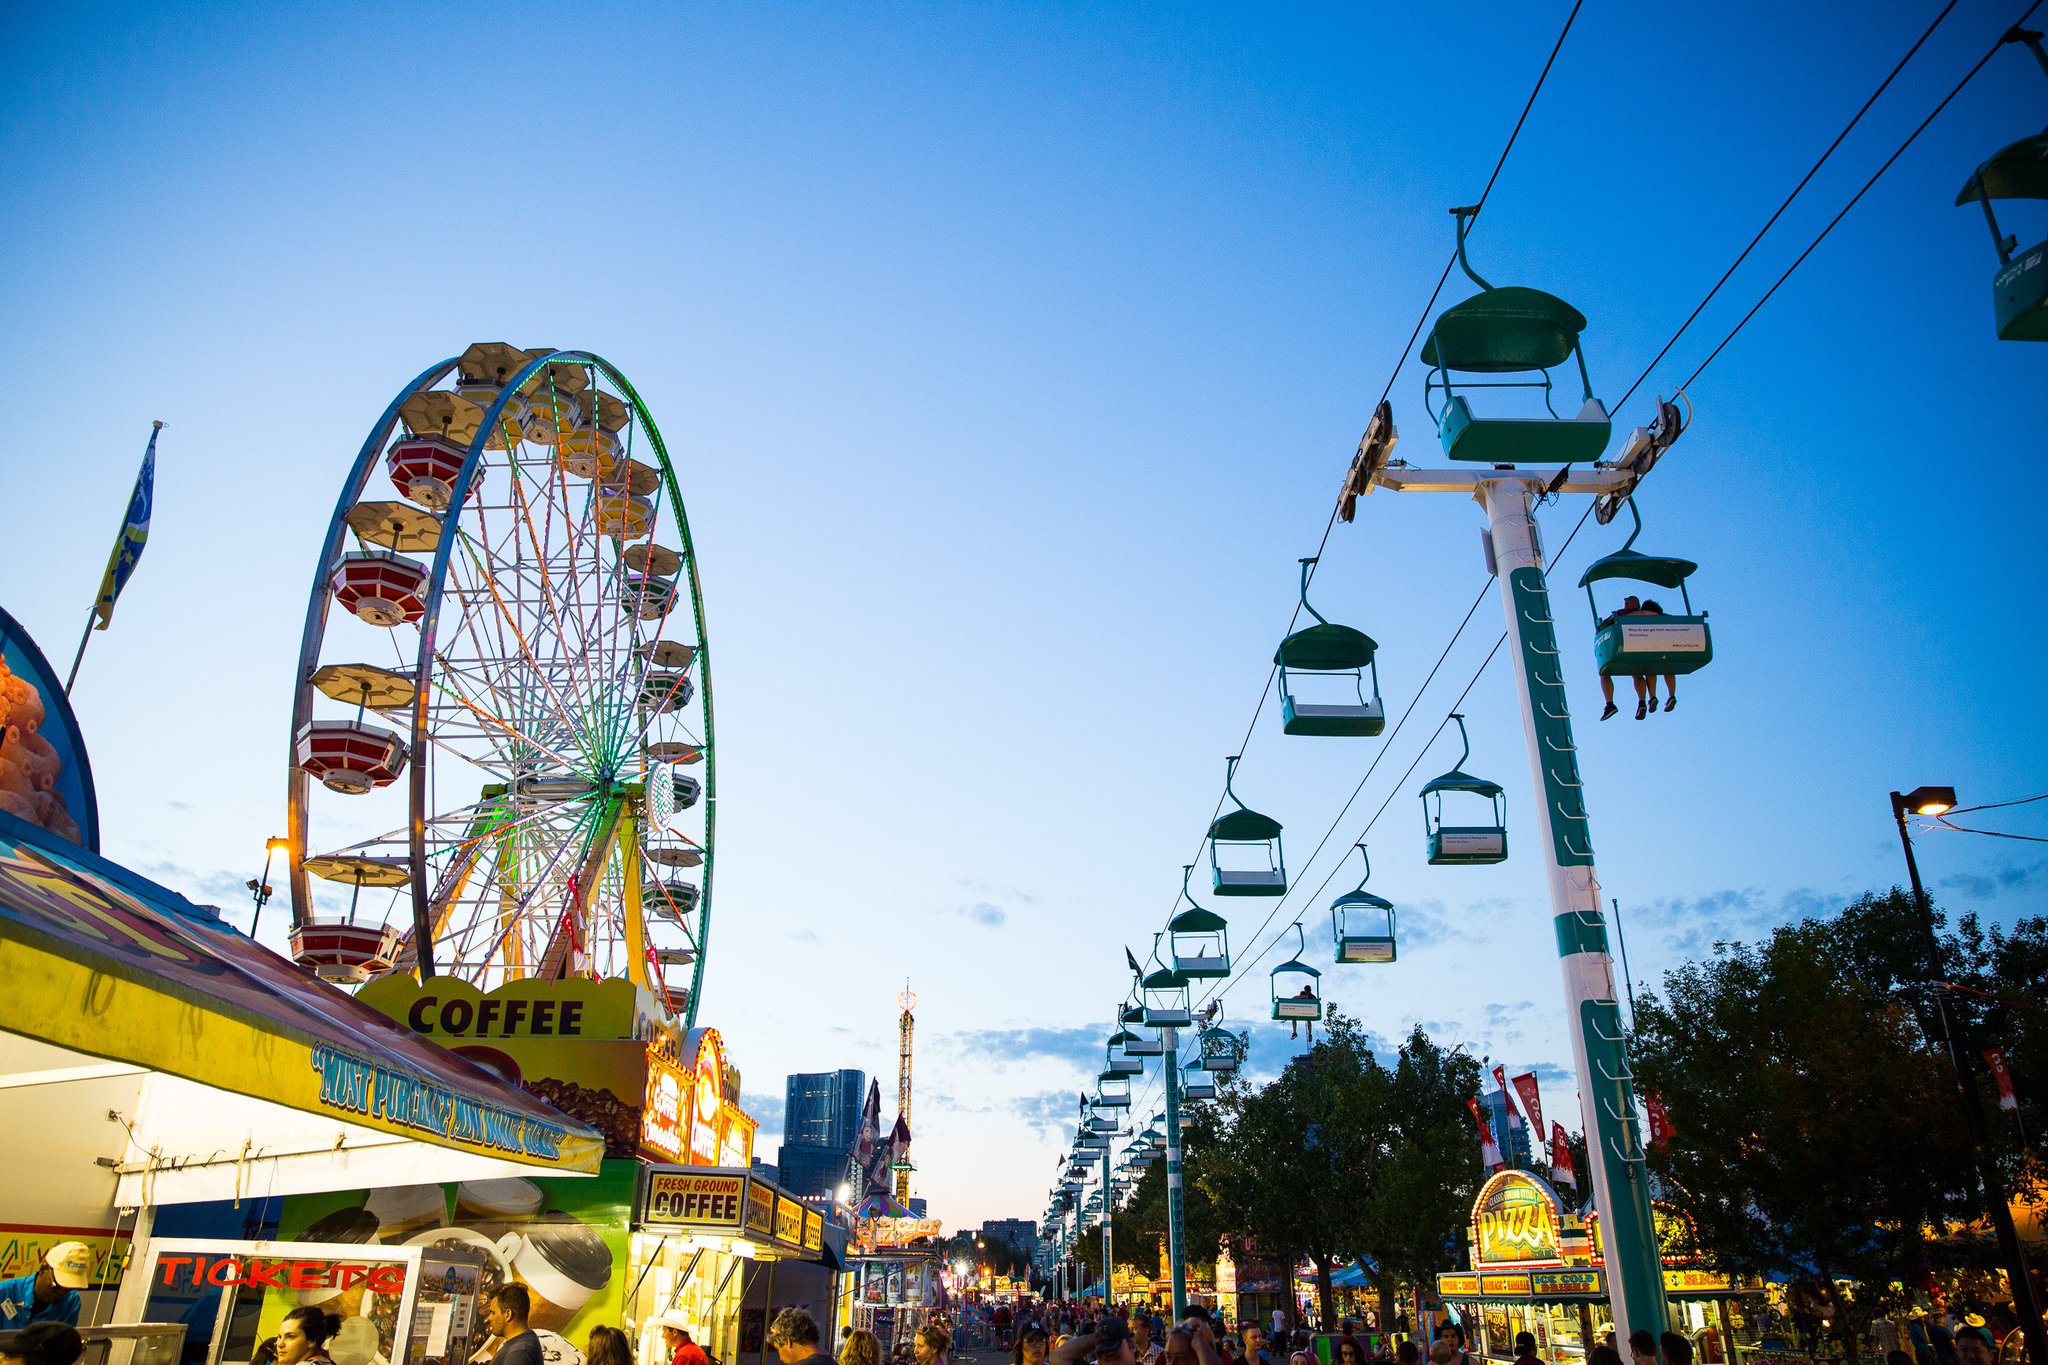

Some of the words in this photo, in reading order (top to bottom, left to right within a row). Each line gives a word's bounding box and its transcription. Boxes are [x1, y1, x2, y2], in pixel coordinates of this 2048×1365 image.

[408, 996, 584, 1035] COFFEE
[656, 1178, 690, 1190] FRESH
[694, 1180, 739, 1193] GROUND
[654, 1192, 738, 1220] COFFEE
[776, 1212, 800, 1240] NACHOS
[1480, 1202, 1556, 1254] PIZZA
[157, 1256, 404, 1294] TICKETS
[1534, 1276, 1558, 1284] ICE
[1560, 1274, 1594, 1284] COLD
[1541, 1284, 1591, 1292] DRINKS
